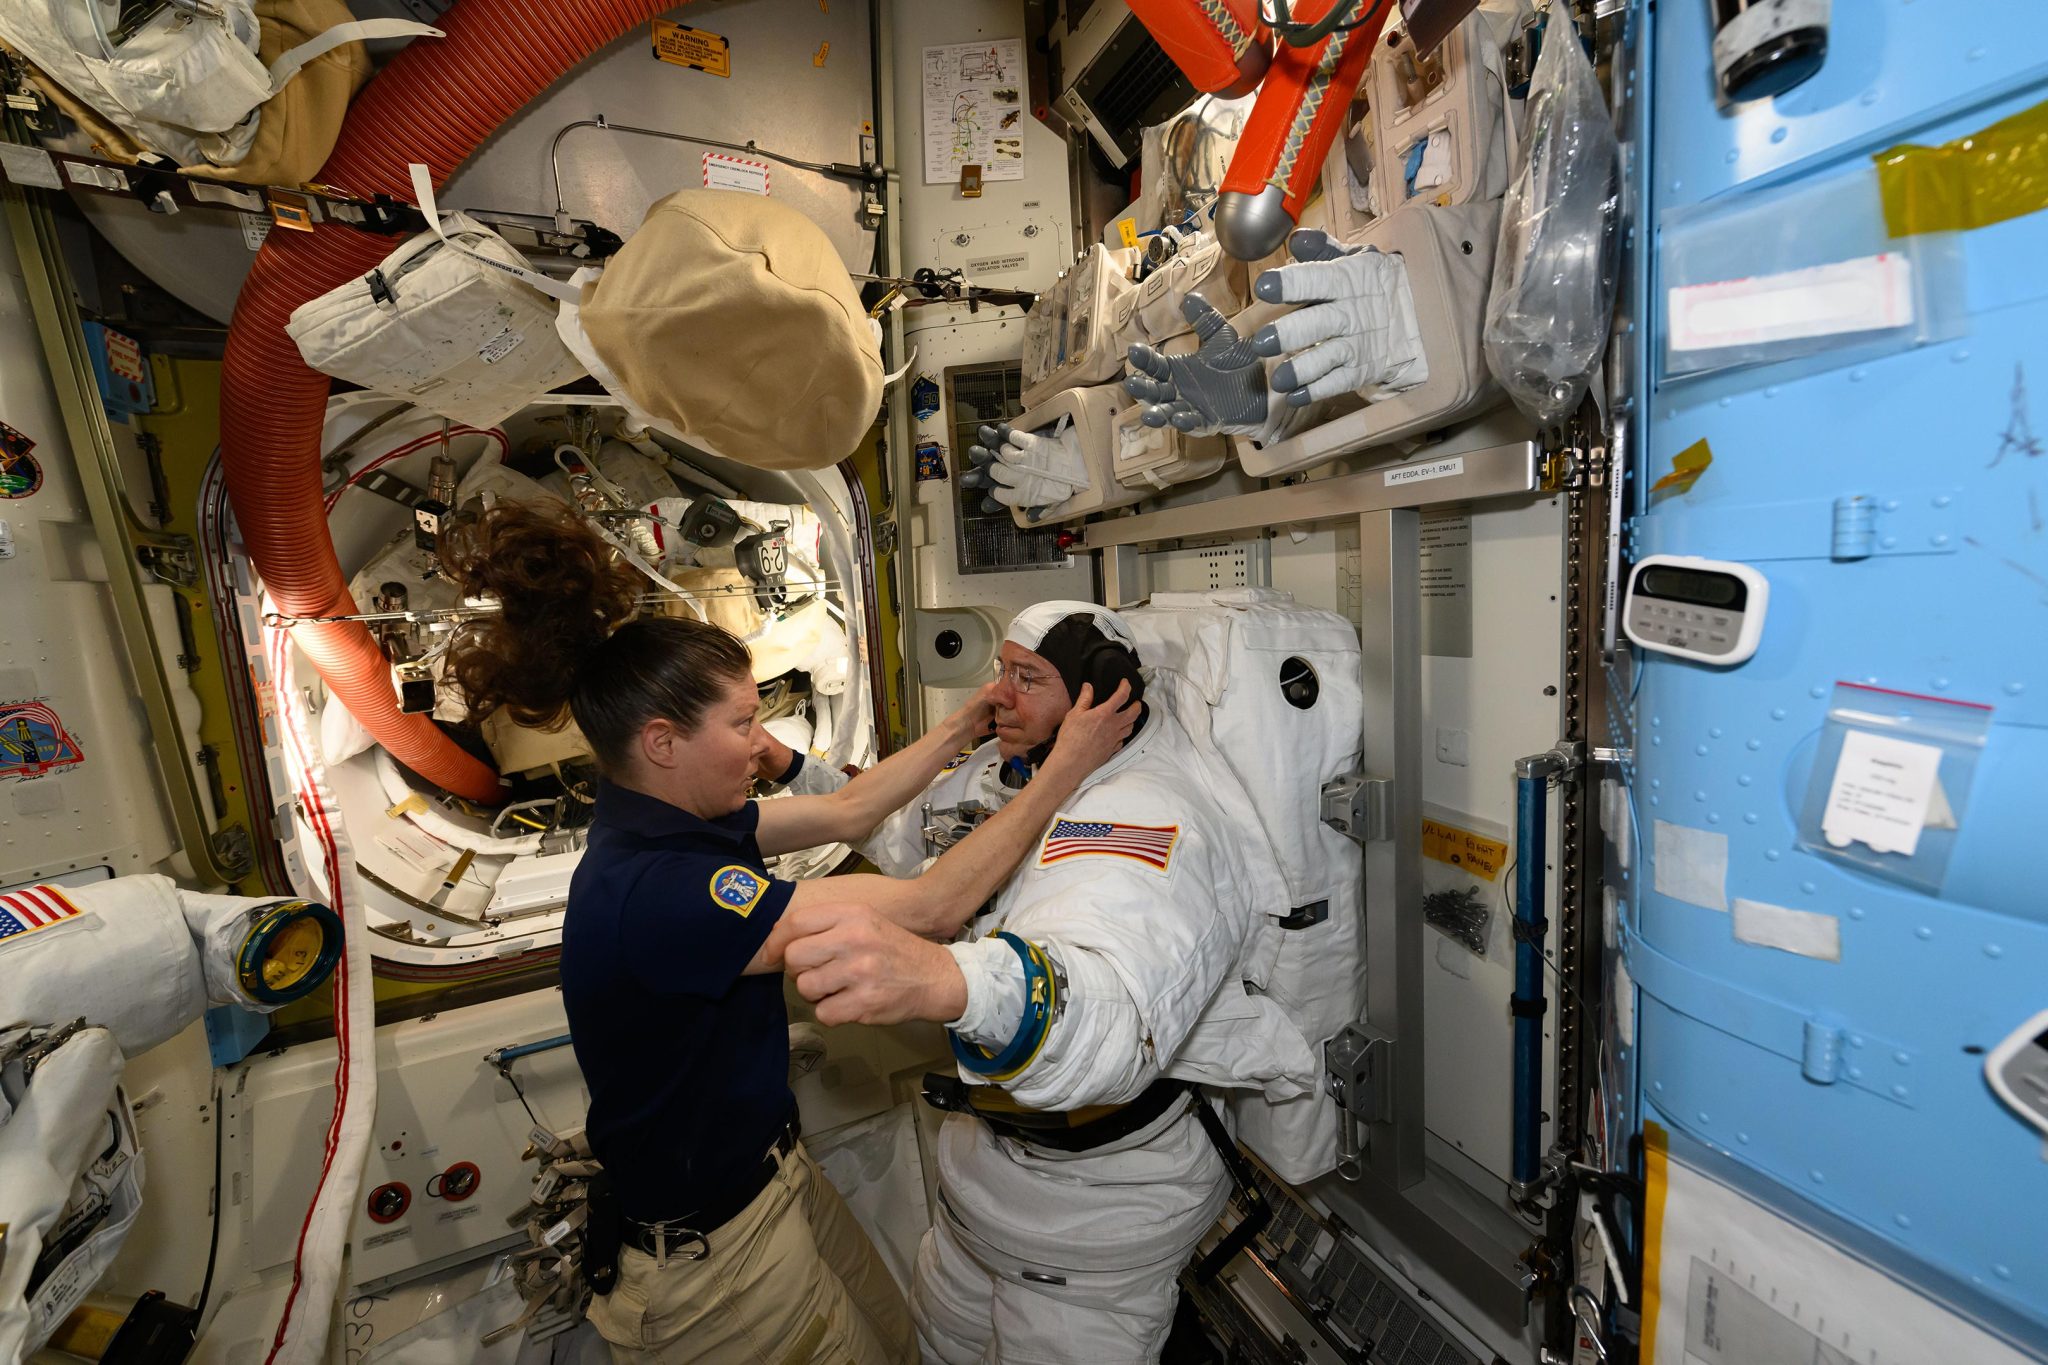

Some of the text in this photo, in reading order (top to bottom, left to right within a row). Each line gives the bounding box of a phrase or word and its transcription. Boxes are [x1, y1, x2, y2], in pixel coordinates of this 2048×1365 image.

[671, 31, 709, 47] WARNING
[1438, 463, 1457, 473] EMU1
[1466, 852, 1496, 874] PANEL
